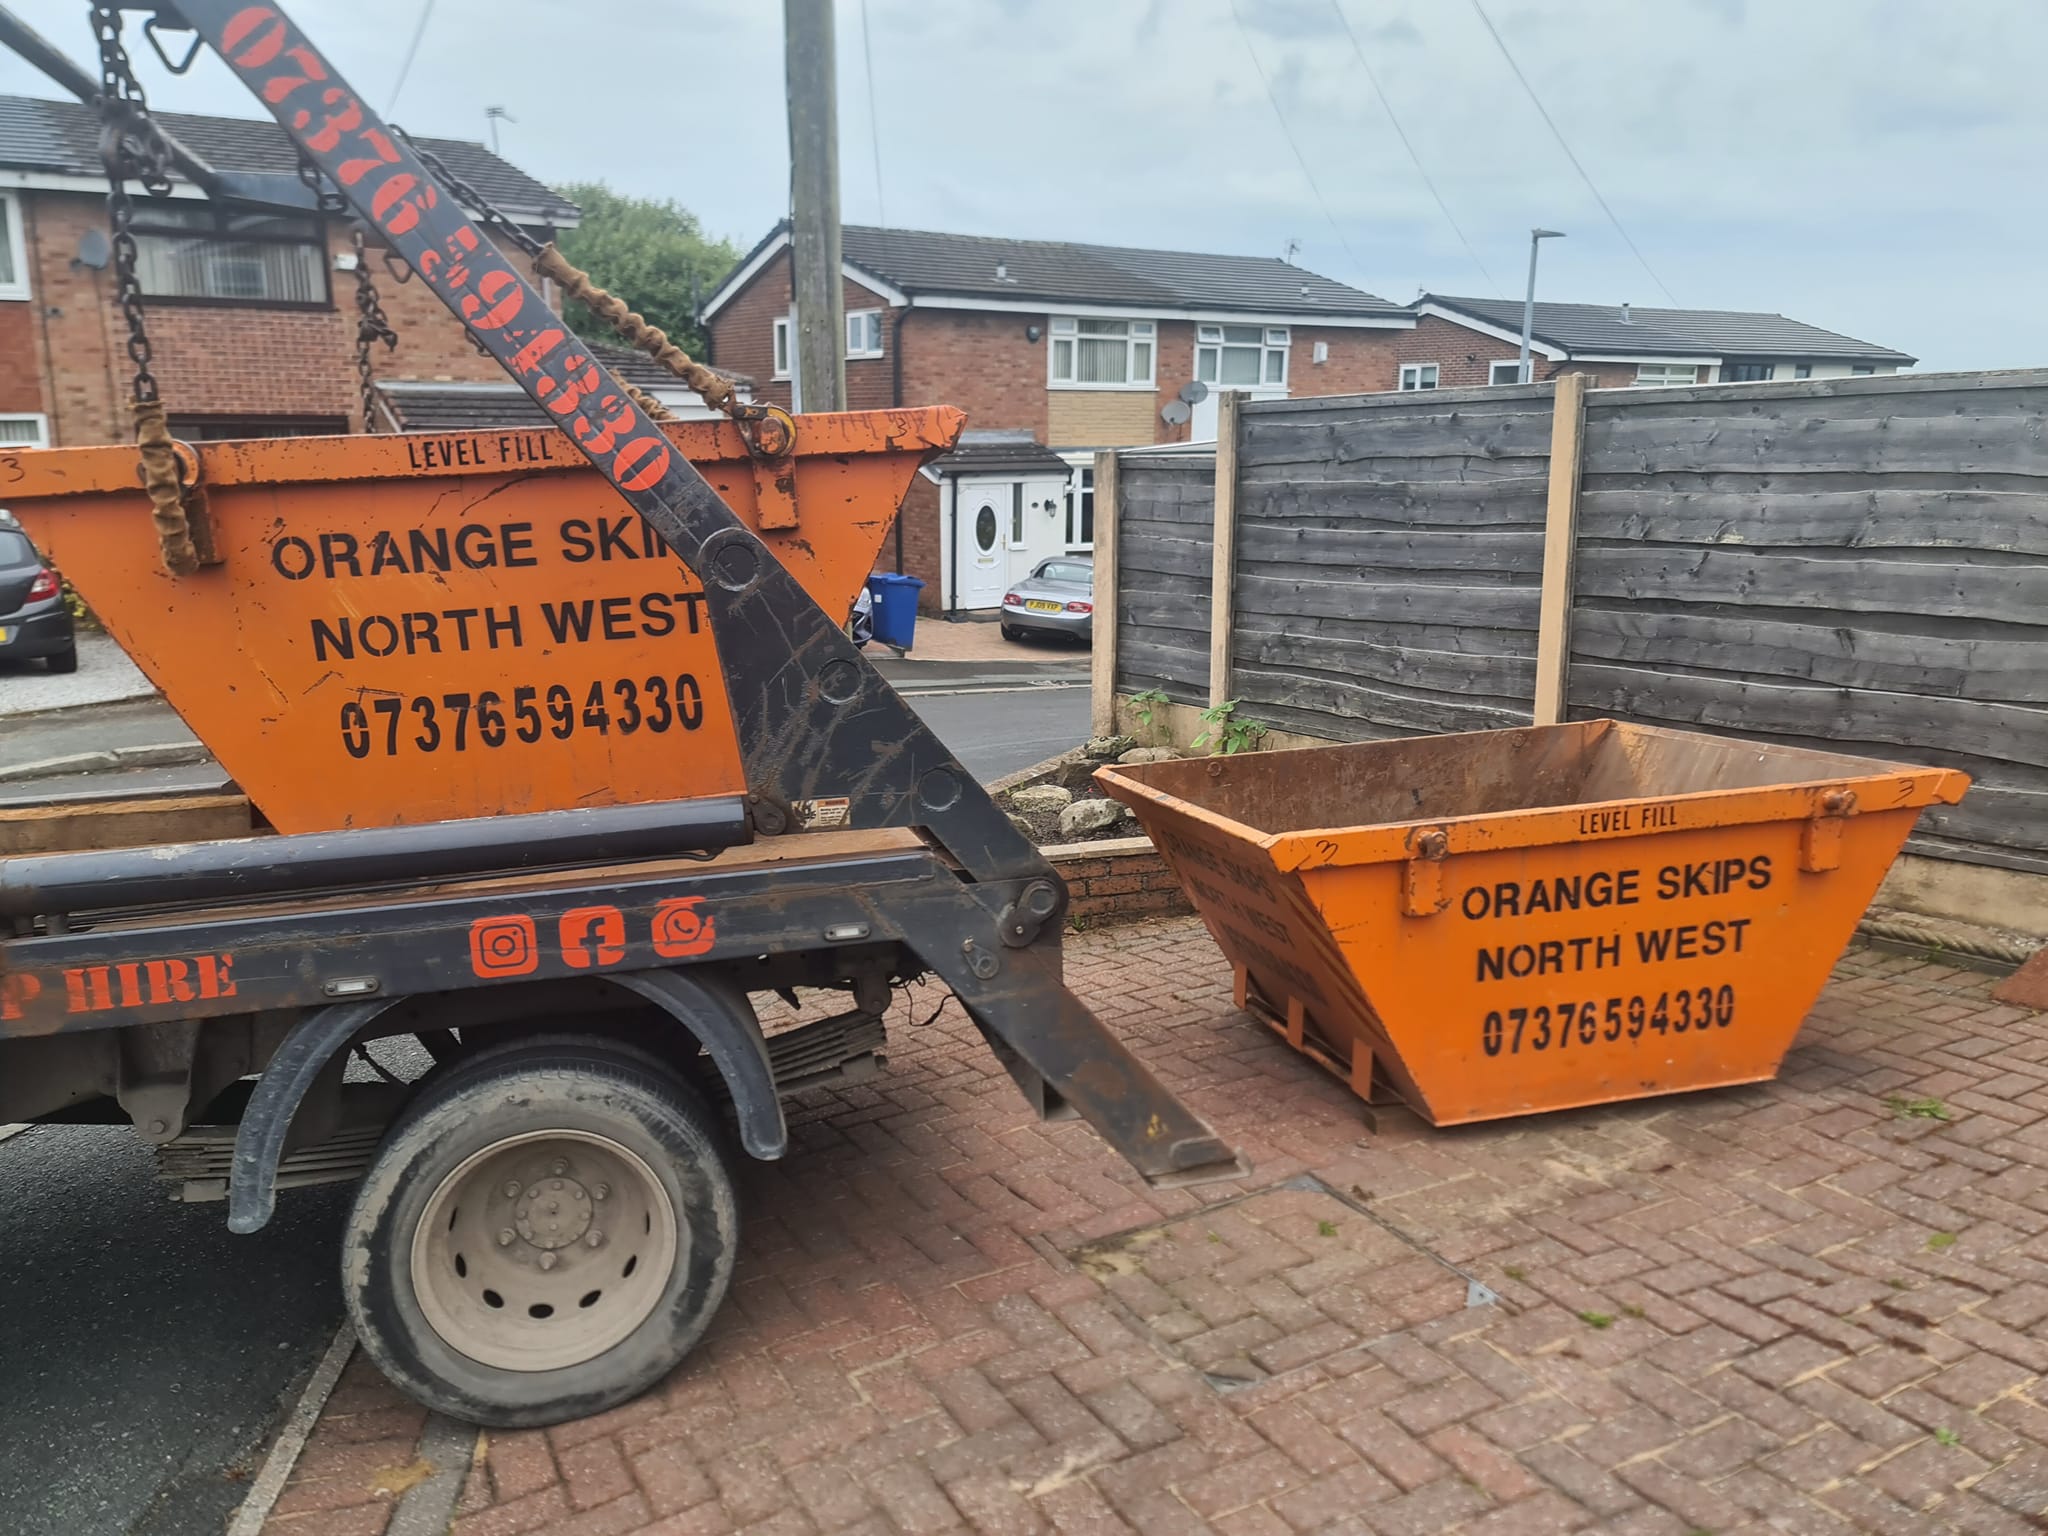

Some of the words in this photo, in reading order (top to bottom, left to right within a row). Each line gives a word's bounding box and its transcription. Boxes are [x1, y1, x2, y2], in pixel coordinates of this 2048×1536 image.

[408, 438, 485, 470] LEVEL
[500, 434, 554, 463] FILL
[272, 522, 538, 580] ORANGE
[310, 605, 523, 662] NORTH
[541, 591, 705, 643] WEST
[340, 673, 704, 759] 07376594330
[1579, 810, 1631, 835] LEVEL
[1641, 806, 1677, 828] FILL
[1461, 869, 1640, 920] ORANGE
[1656, 855, 1772, 900] SKIPS
[1476, 934, 1620, 982] NORTH
[1636, 918, 1751, 964] WEST
[62, 954, 237, 1013] HIRE
[1483, 984, 1734, 1057] 07376594330
